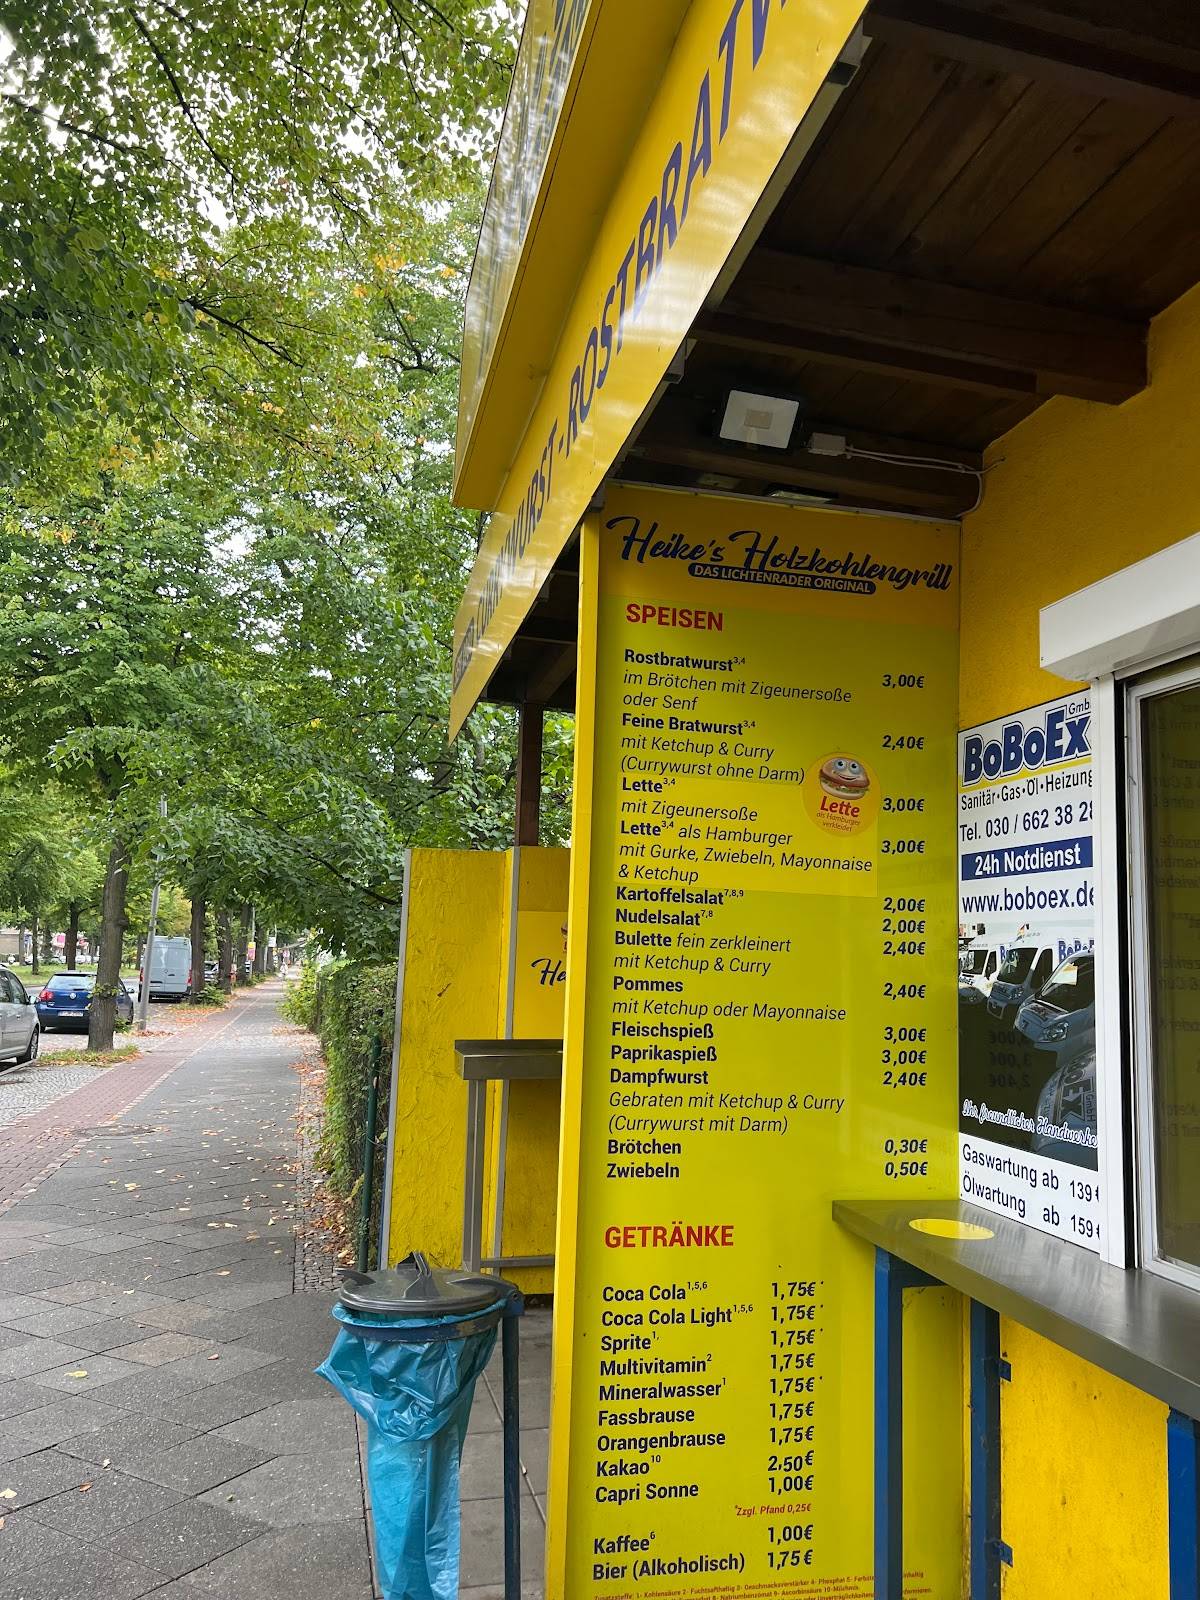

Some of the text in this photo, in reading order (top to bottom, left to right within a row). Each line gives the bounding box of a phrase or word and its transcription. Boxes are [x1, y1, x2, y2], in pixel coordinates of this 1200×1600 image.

[606, 516, 953, 591] Heike's Holzkohlengrill
[694, 564, 871, 593] DAS LICHTENRADER ORIGINAL
[626, 603, 724, 632] SPEISEN
[623, 669, 852, 703] im Brötchen mit Zigeunersoße
[882, 674, 925, 689] 3,00€
[623, 692, 699, 711] oder Senf
[622, 713, 665, 729] Feine
[621, 734, 775, 762] mit Ketchup & Curry
[882, 735, 925, 751] 2,40€
[621, 755, 805, 785] (Currywurst ohne Darm)
[621, 798, 758, 822] mit Zigeunersoße
[820, 795, 860, 818] Lette
[882, 797, 925, 813] 3,00€
[960, 822, 981, 842] Tel.
[985, 816, 1009, 838] 030
[1013, 813, 1019, 834] /
[1022, 808, 1049, 832] 662
[1054, 804, 1073, 826] 38
[678, 824, 701, 839] als
[705, 826, 793, 848] Hamburger
[619, 842, 873, 872] mit Gurke, Zwiebeln, Mayonnaise
[881, 840, 925, 855] 3,00€
[974, 842, 1081, 876] 24h Notdienst
[618, 864, 699, 885] & Ketchup
[883, 897, 926, 913] 2,00€
[882, 918, 926, 935] 2,00€
[615, 931, 792, 953] Bulette fein zerkleinert
[882, 941, 926, 956] 2,40€
[613, 953, 771, 977] mit Ketchup & Curry
[613, 976, 684, 992] Pommes
[883, 982, 927, 1000] 2,40€
[612, 998, 846, 1021] mit Ketchup oder Mayonnaise
[611, 1021, 714, 1041] Fleischspieß
[883, 1026, 927, 1044] 3,00€
[610, 1045, 717, 1064] Paprikaspieß
[881, 1050, 927, 1067] 3,00€
[610, 1068, 709, 1087] Dampfwurst
[883, 1071, 927, 1088] 2,40€
[609, 1091, 845, 1114] Gebraten mit Ketchup & Curry
[608, 1114, 788, 1135] (Currywurst mit Darm)
[978, 1102, 1036, 1133] freundlicher
[607, 1138, 682, 1155] Brötchen
[884, 1139, 928, 1156] 0,30€
[606, 1162, 680, 1178] Zwiebeln
[884, 1161, 928, 1178] 0,50€
[962, 1143, 1037, 1188] Gaswartung
[1042, 1169, 1059, 1190] ab
[1069, 1179, 1092, 1202] 139
[962, 1170, 1026, 1219] Ölwartung
[1043, 1204, 1060, 1226] ab
[1070, 1214, 1093, 1238] 159
[604, 1221, 735, 1248] GETRÄNKE
[602, 1286, 644, 1302] Coca
[601, 1310, 644, 1327] Coca
[648, 1308, 685, 1325] Cola
[770, 1353, 816, 1373] 1,75€
[598, 1408, 695, 1427] Fassbrause
[769, 1401, 815, 1421] 1,75€
[597, 1431, 726, 1453] Orangenbrause
[769, 1426, 815, 1446] 1,75€
[767, 1450, 815, 1473] 2,50€
[595, 1483, 699, 1505] Capri Sonne
[768, 1475, 814, 1495] 1,00€
[760, 1505, 785, 1515] Pfand
[787, 1503, 812, 1514] 0,25€
[768, 1524, 814, 1545] 1,00€
[593, 1552, 745, 1582] Bier (Alkoholisch)
[767, 1549, 814, 1570] 1,75€
